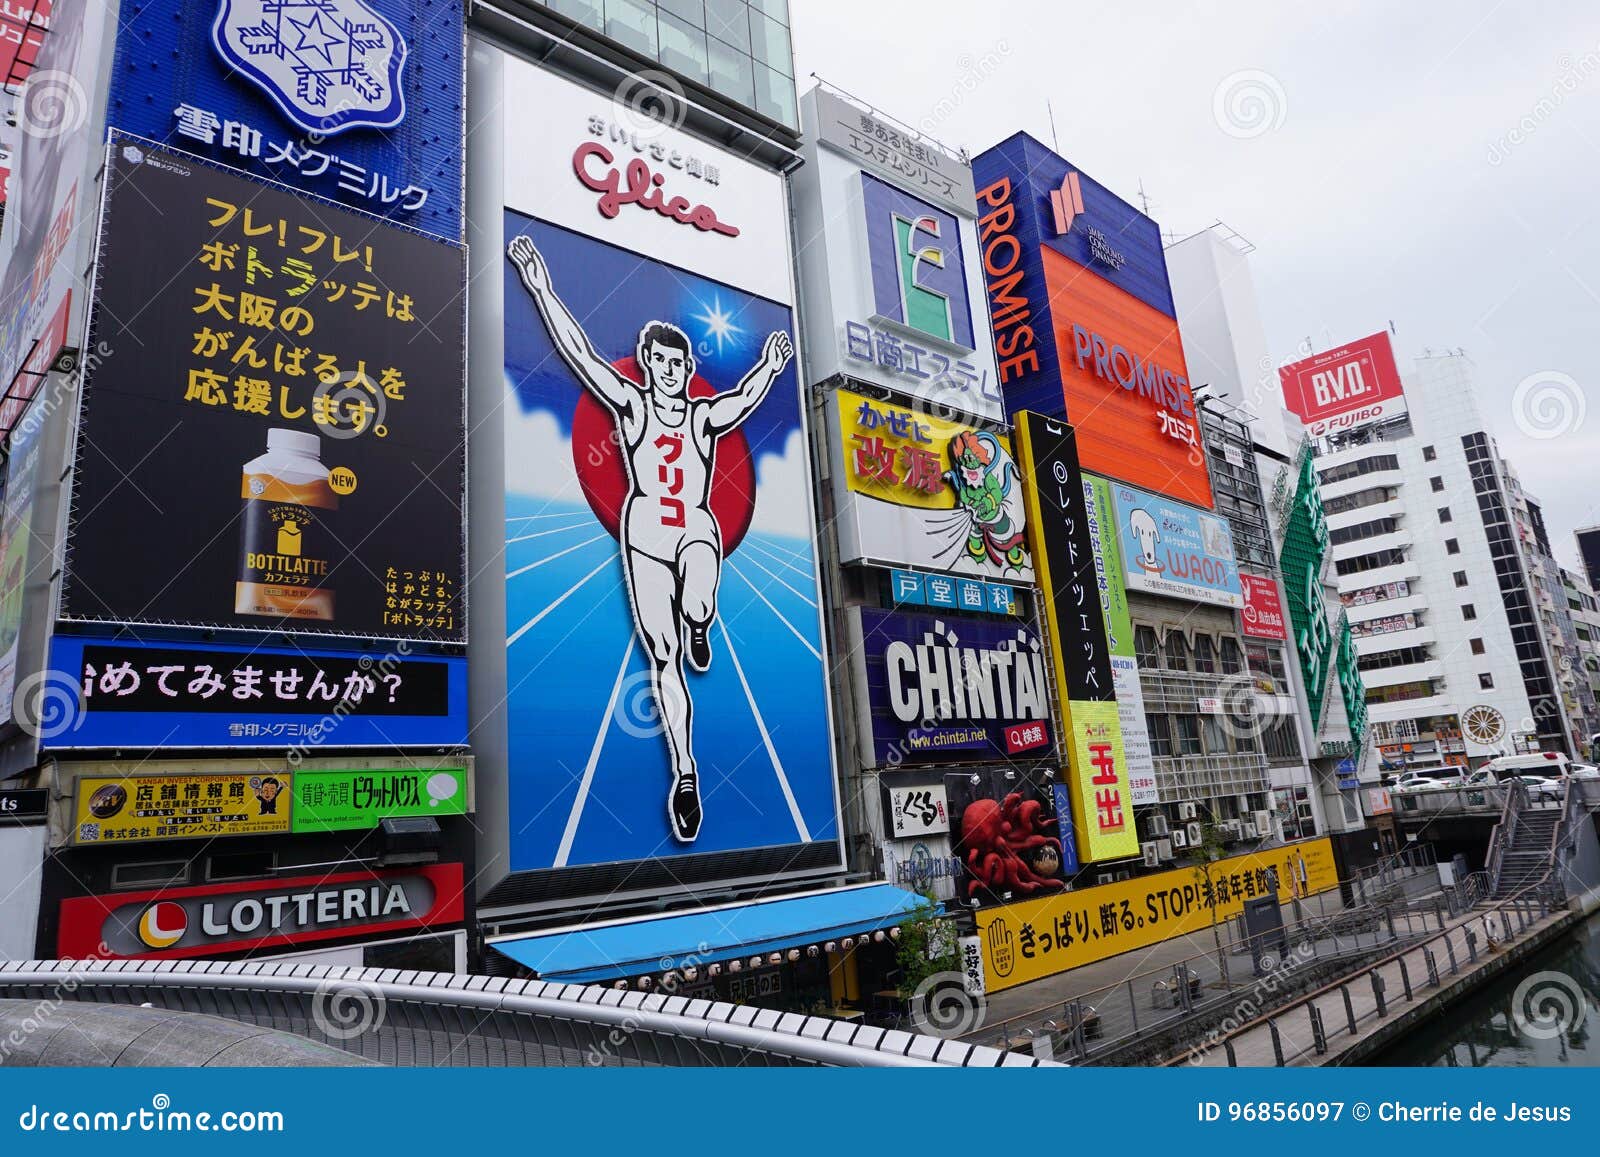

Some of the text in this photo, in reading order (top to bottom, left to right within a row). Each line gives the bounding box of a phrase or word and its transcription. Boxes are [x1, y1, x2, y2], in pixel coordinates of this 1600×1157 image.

[174, 102, 428, 212] 雪印メグミルク
[859, 114, 940, 167] 夢ある住まい
[848, 134, 954, 199] エステムシリーズ
[198, 241, 415, 322] ボトラッテは
[977, 177, 1039, 383] PROMISE
[193, 284, 314, 336] 大阪の
[192, 327, 406, 401] がんばる人を
[1073, 322, 1193, 418] PROMISE
[184, 368, 389, 439] 応援します。
[856, 401, 932, 444] かぜに
[1329, 406, 1383, 428] FUJIBO
[1157, 409, 1198, 447] プロミス
[331, 472, 355, 489] NEW
[653, 432, 686, 528] グリコ
[852, 433, 946, 495] 改源
[246, 552, 328, 576] BOTTLATTE
[264, 572, 311, 584] カフェラテ
[1167, 548, 1228, 586] WAON
[899, 574, 1009, 609] 戸堂歯科
[228, 722, 324, 738] 雪印メグミルク
[909, 728, 987, 748] www.chintai.net
[1021, 726, 1043, 744] 検索
[136, 782, 245, 801] 店舗情報館
[353, 775, 421, 809] ピタットハウス
[1088, 742, 1125, 835] 玉出
[104, 824, 224, 839] 株式会社 関西インベスト
[202, 884, 411, 936] LOTTERIA
